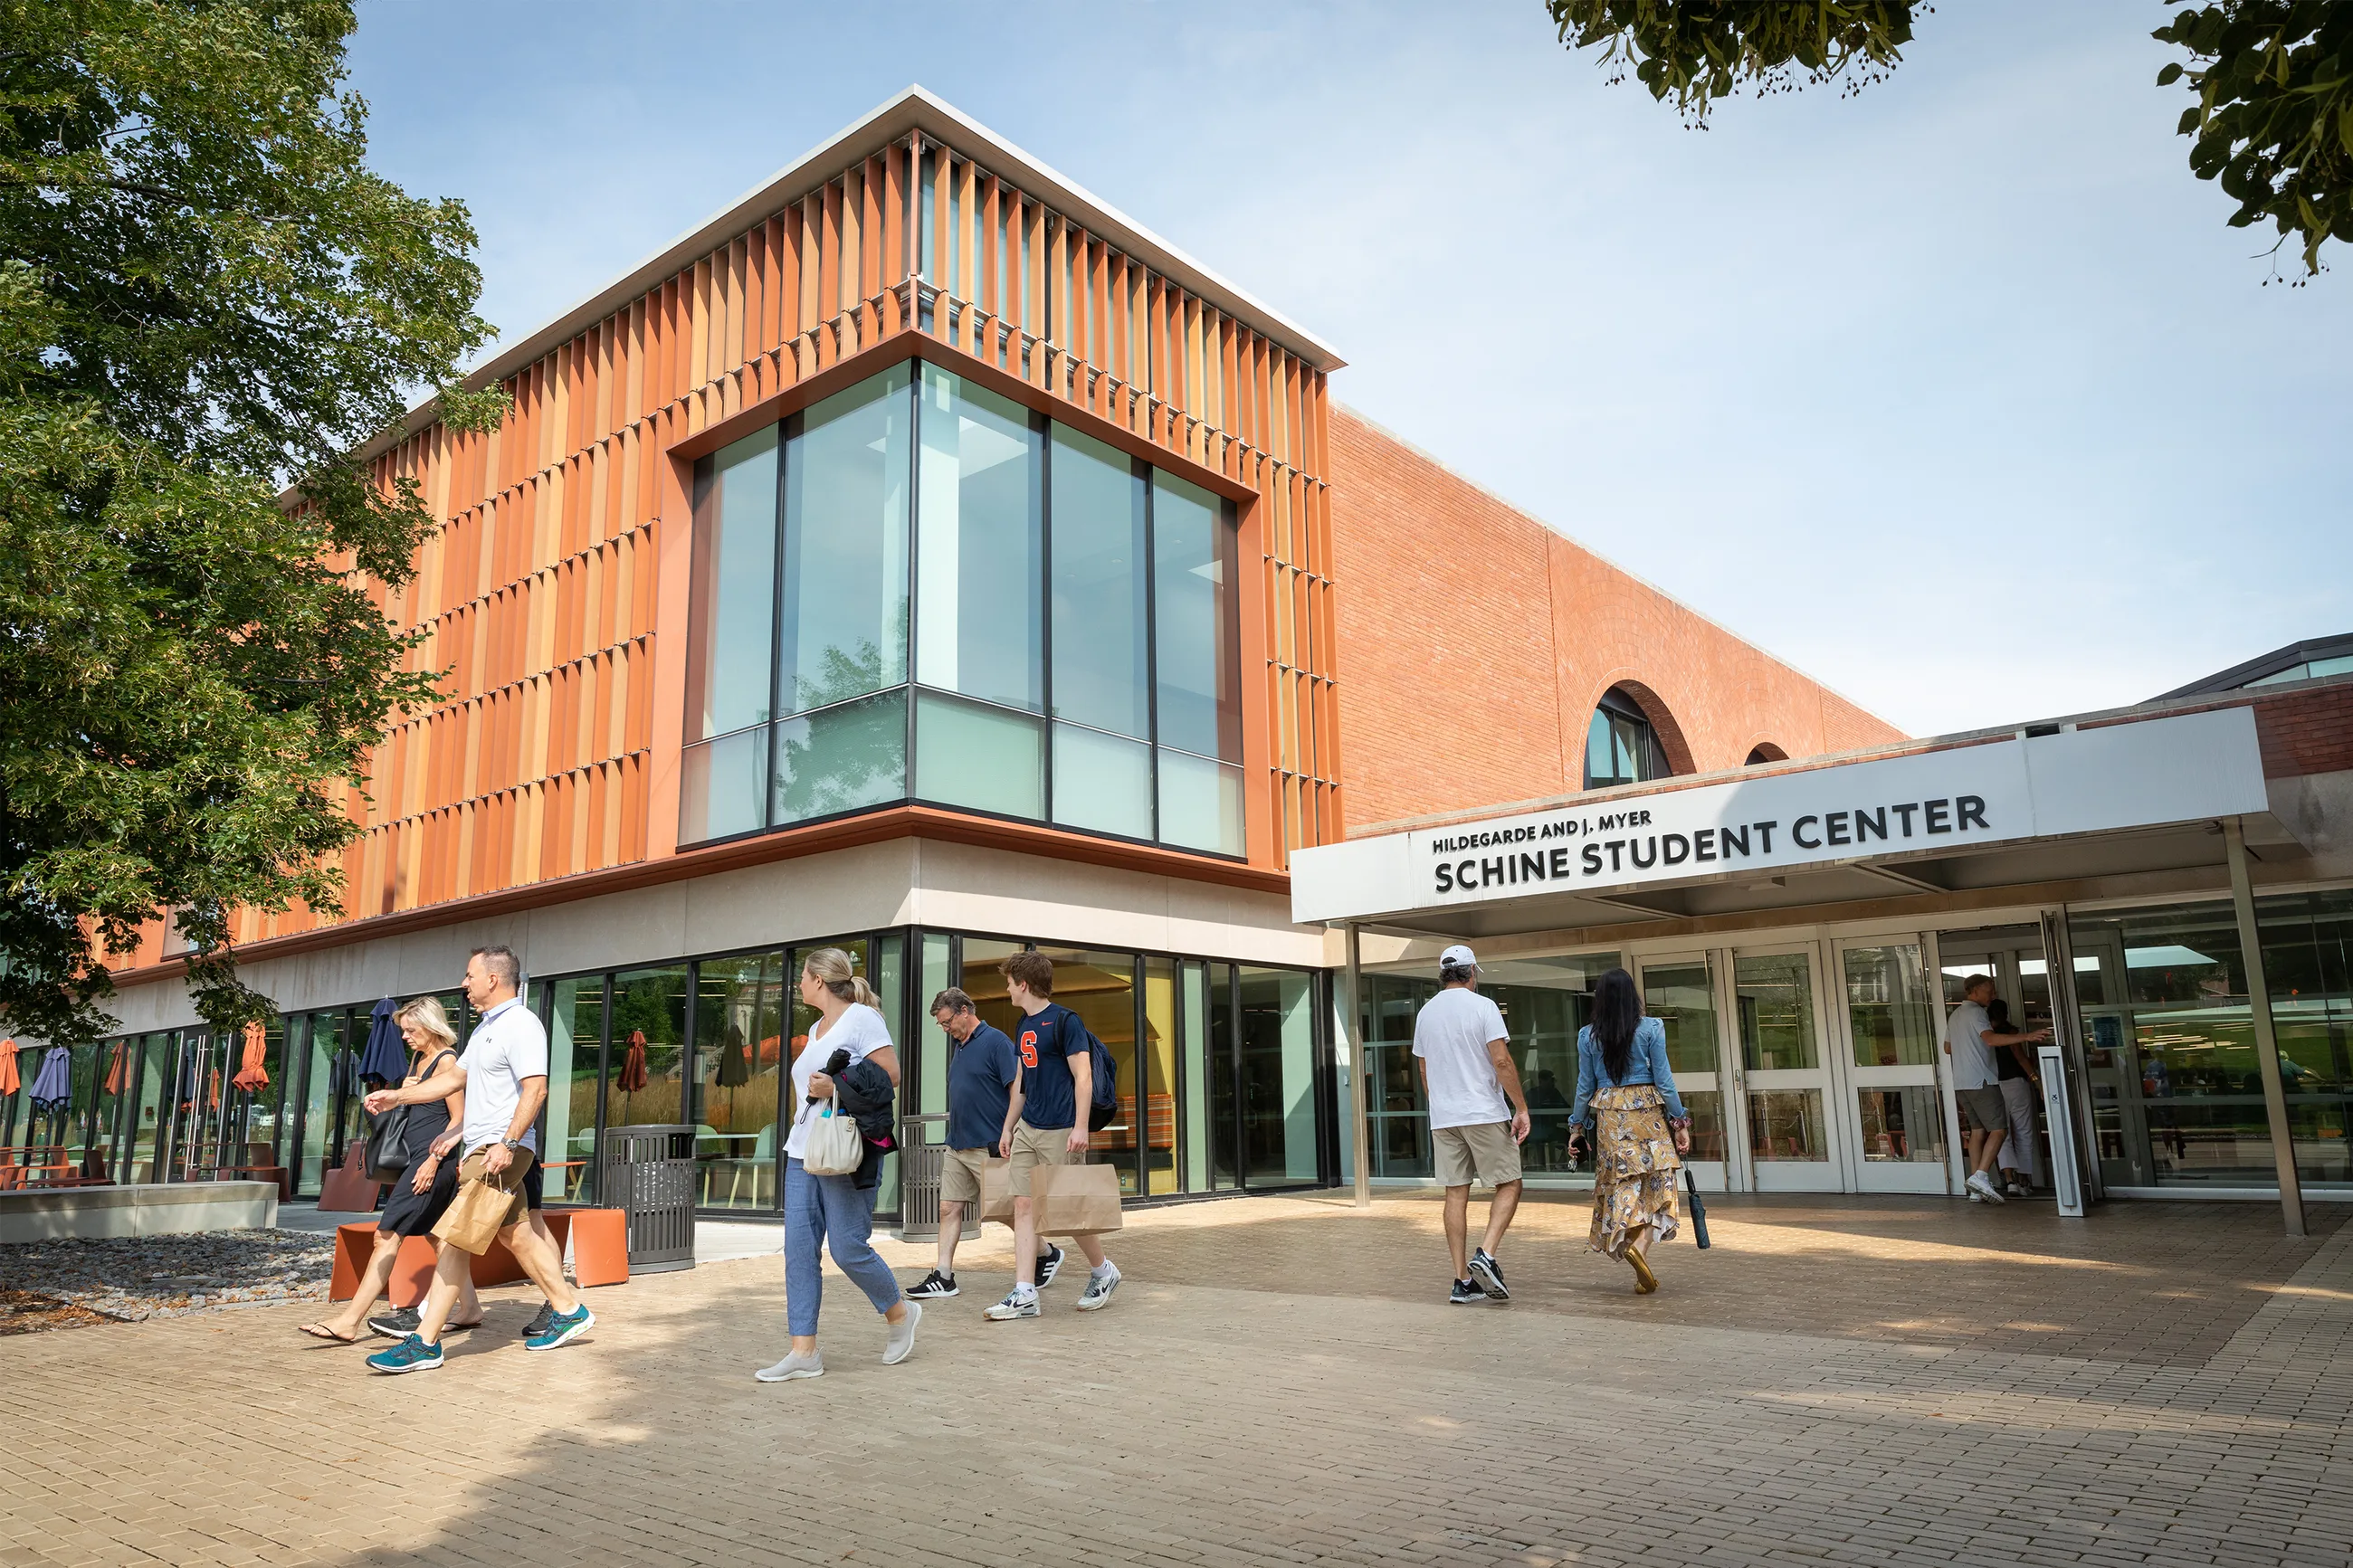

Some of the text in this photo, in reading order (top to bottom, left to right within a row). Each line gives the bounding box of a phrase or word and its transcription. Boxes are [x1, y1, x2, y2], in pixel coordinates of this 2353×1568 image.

[1433, 810, 1652, 853] HILDEGARDE AND J. MYER
[1434, 794, 1991, 893] SCHINE STUDENT CENTER
[1020, 1030, 1039, 1068] S
